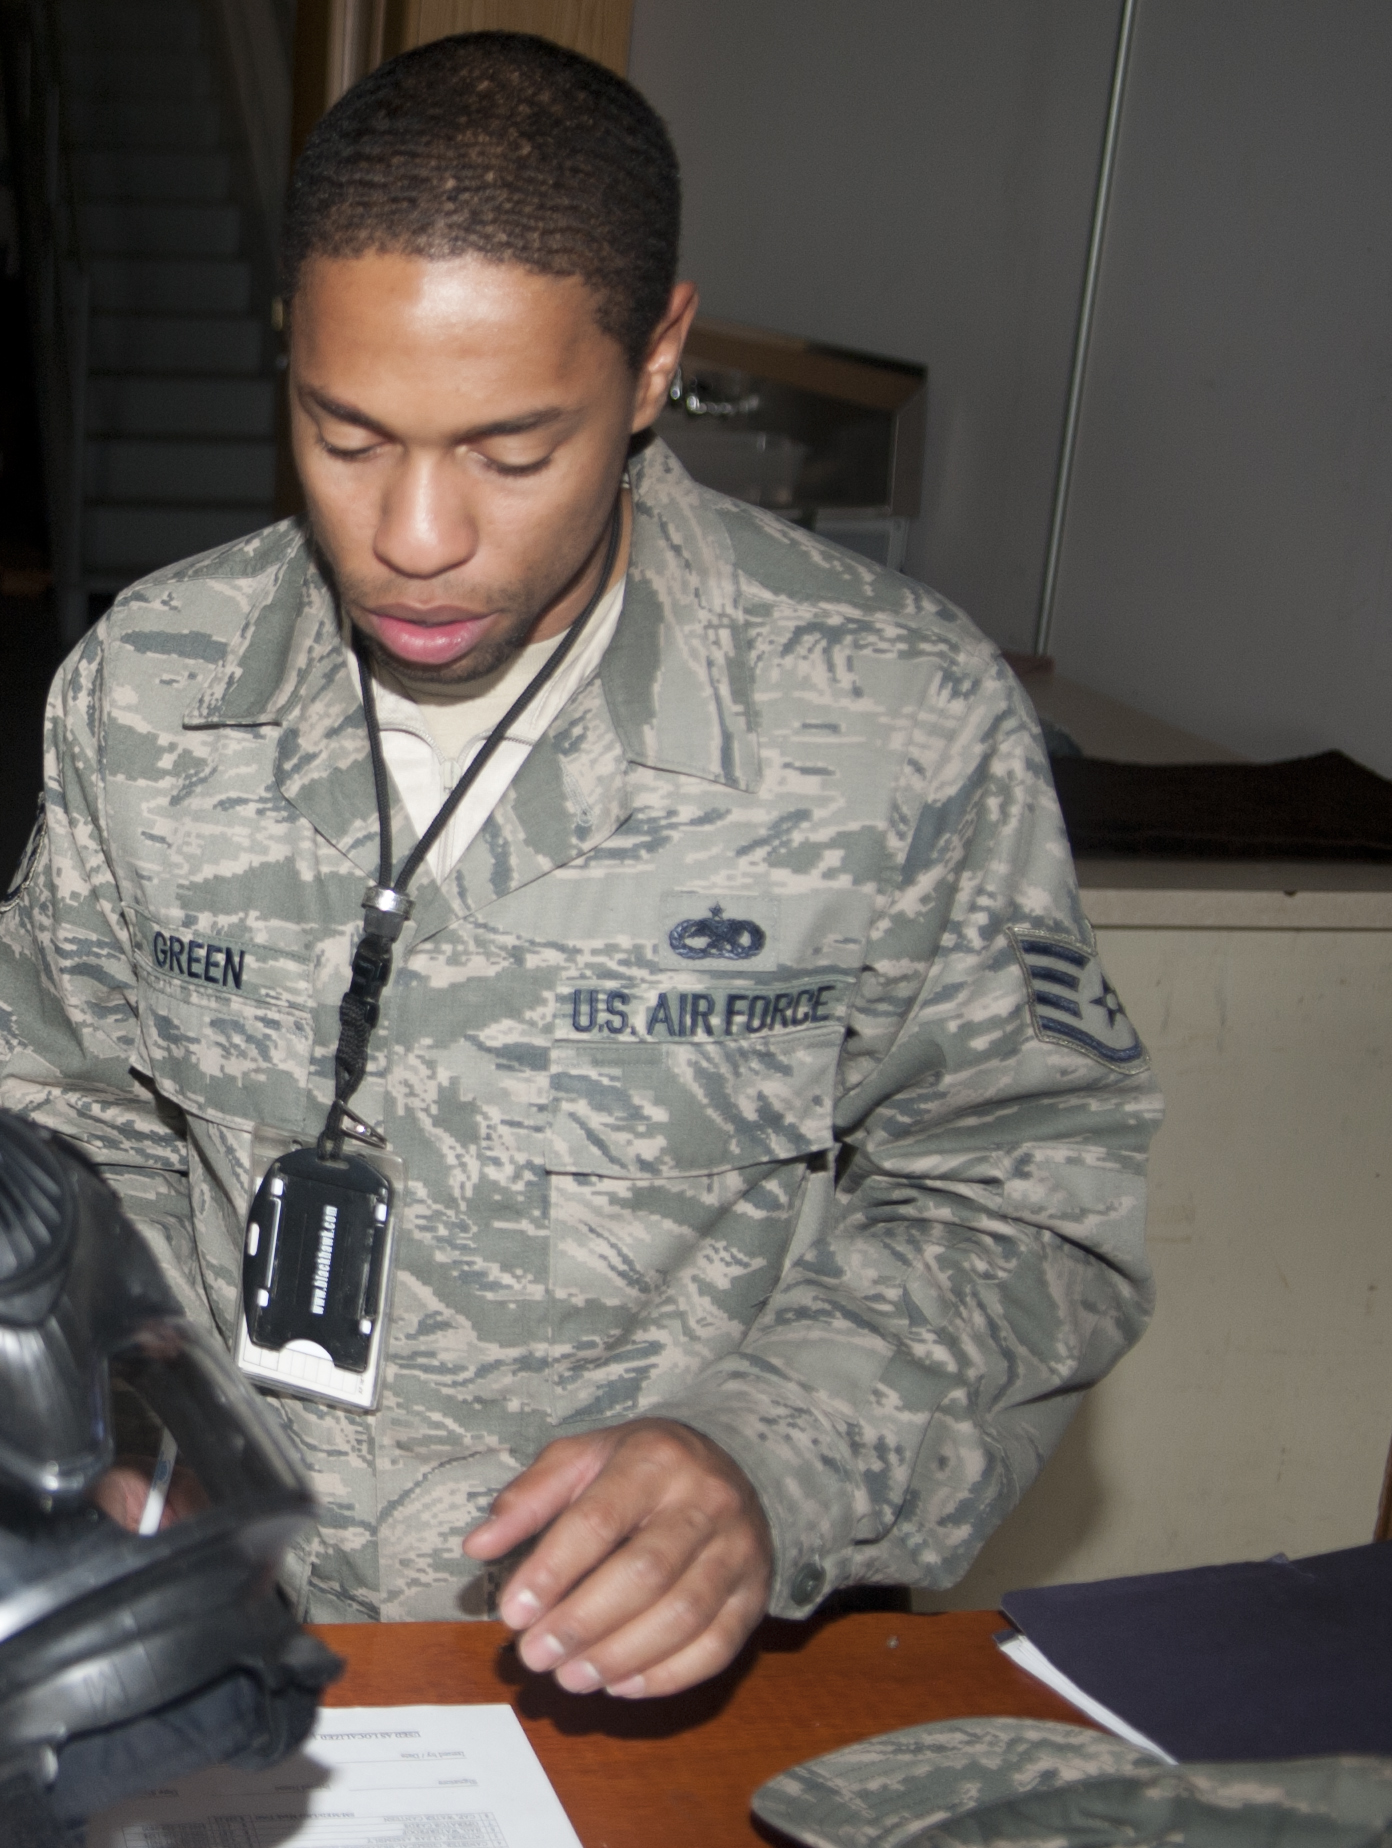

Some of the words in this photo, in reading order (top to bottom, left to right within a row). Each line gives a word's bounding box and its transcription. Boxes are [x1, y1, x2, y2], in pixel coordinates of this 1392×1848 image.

[153, 930, 246, 990] GREEN
[572, 988, 638, 1035] U.S.
[647, 991, 716, 1037] AIR
[724, 984, 837, 1036] FORCE
[310, 1204, 338, 1315] www.blackhawk.com
